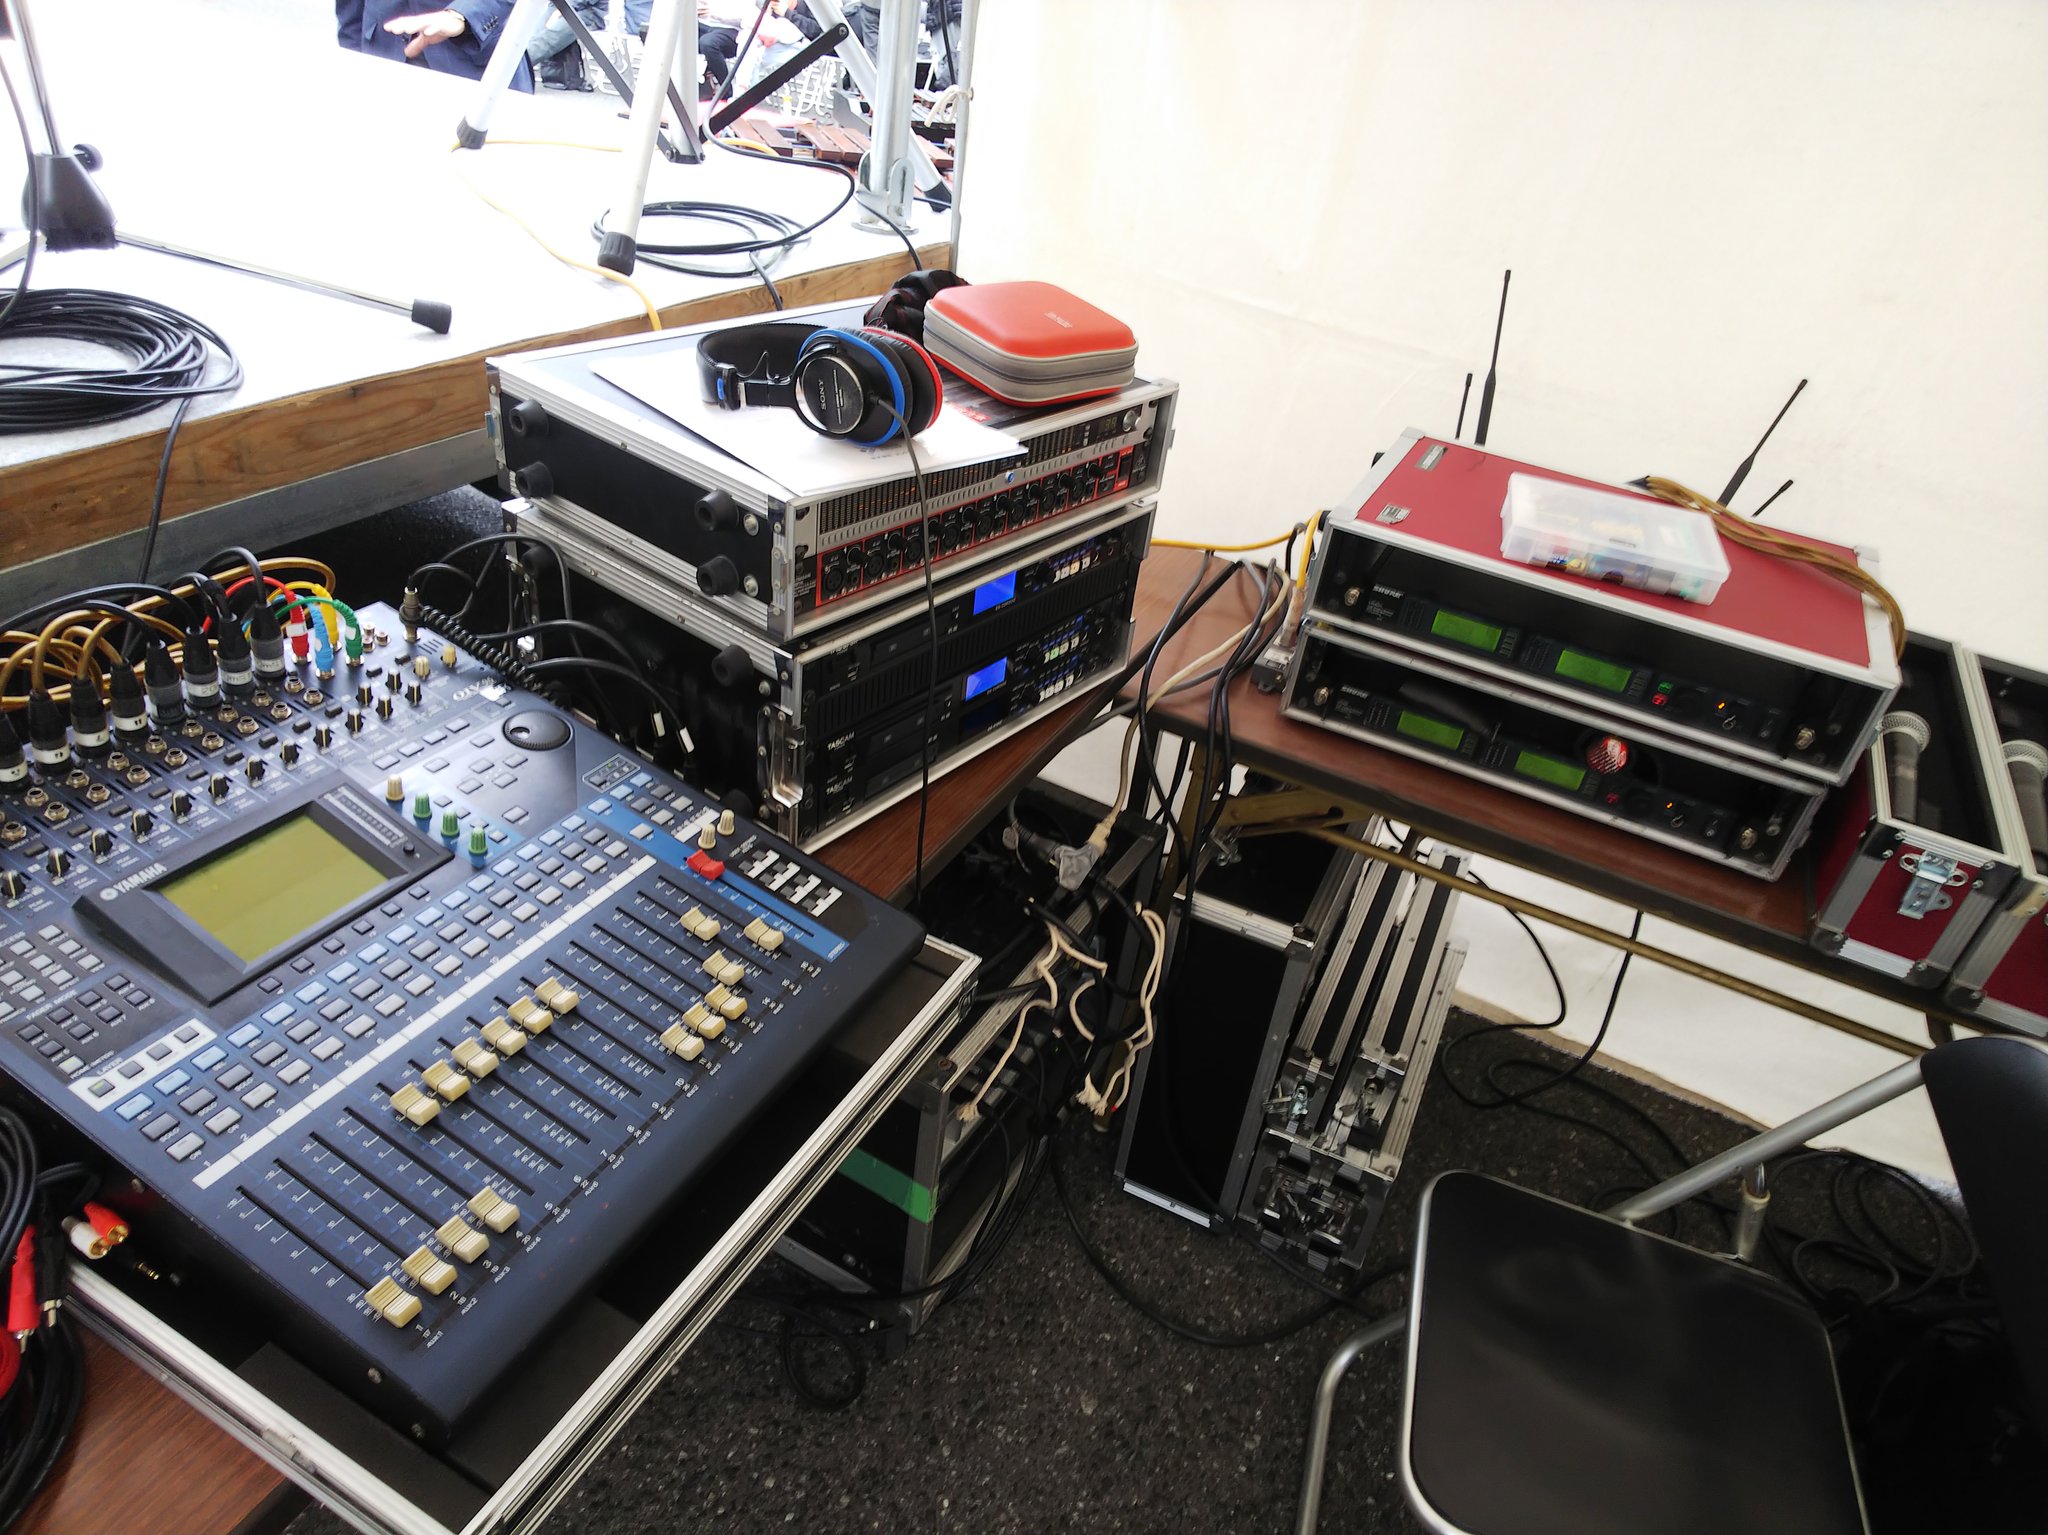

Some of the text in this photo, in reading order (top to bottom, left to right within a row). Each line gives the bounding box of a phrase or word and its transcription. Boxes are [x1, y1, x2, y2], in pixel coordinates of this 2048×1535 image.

[827, 731, 855, 751] TASCAM
[113, 862, 168, 893] YAMAHA
[26, 1003, 53, 1020] FADER
[54, 989, 78, 1004] MODE
[762, 996, 771, 1005] 14
[742, 1016, 751, 1024] 13
[721, 1036, 729, 1044] 12
[97, 1057, 122, 1074] LAYER
[699, 1057, 707, 1065] 11
[675, 1077, 684, 1087] 10
[651, 1101, 660, 1109] 9
[626, 1124, 635, 1133] 8
[638, 1130, 651, 1145] AUX8
[600, 1149, 608, 1157] 7
[612, 1154, 624, 1170] AUX7
[573, 1174, 582, 1183] 6
[584, 1180, 599, 1196] AUX6
[544, 1202, 553, 1210] 5
[556, 1207, 571, 1224] AUX5
[516, 1230, 523, 1238] 4
[526, 1236, 542, 1253] AUX4
[482, 1260, 492, 1269] 3
[494, 1266, 511, 1283] AUX3
[449, 1291, 459, 1300] 2
[461, 1297, 478, 1315] AUX2
[426, 1331, 443, 1348] AUX1
